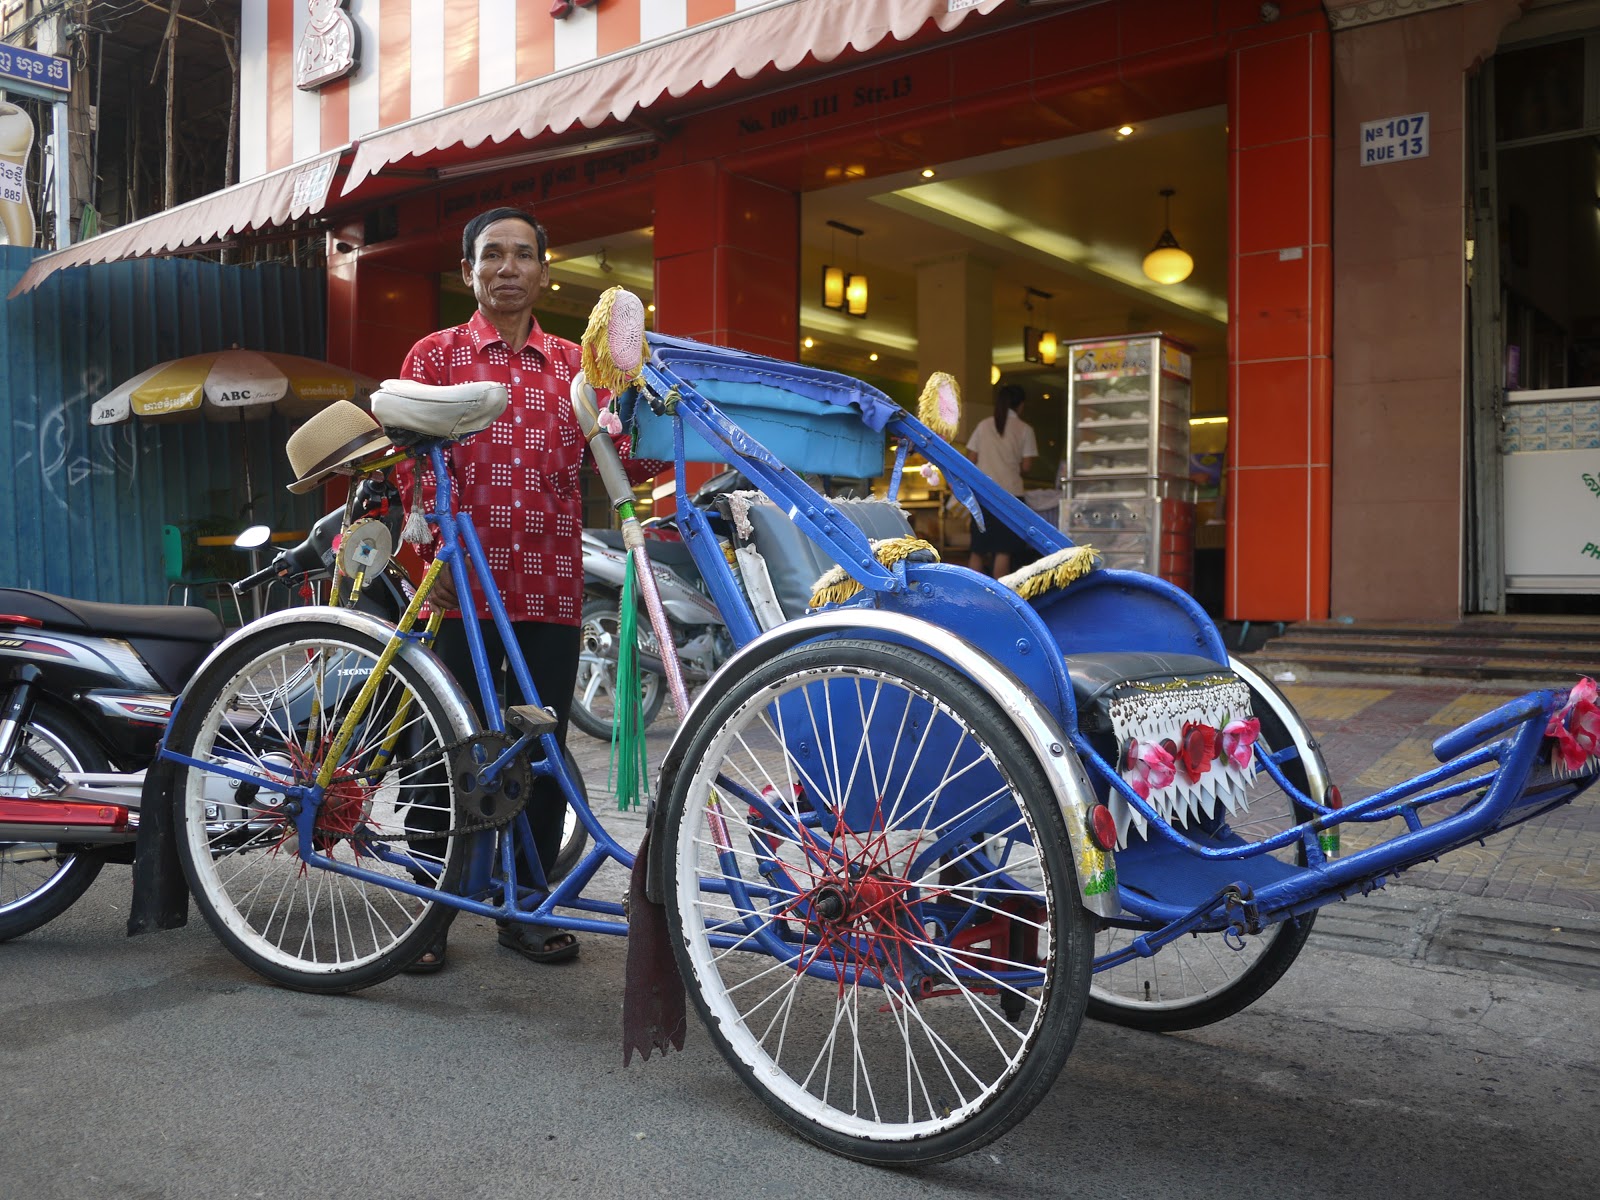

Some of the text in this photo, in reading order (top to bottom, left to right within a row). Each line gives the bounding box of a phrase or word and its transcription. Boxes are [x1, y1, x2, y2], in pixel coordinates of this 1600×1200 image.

[1385, 116, 1424, 138] 107
[1366, 137, 1423, 162] RUE 13
[4, 188, 21, 202] 885
[220, 390, 251, 402] ABC
[97, 408, 116, 420] ABC
[337, 667, 390, 677] HON
[133, 705, 167, 717] 125
